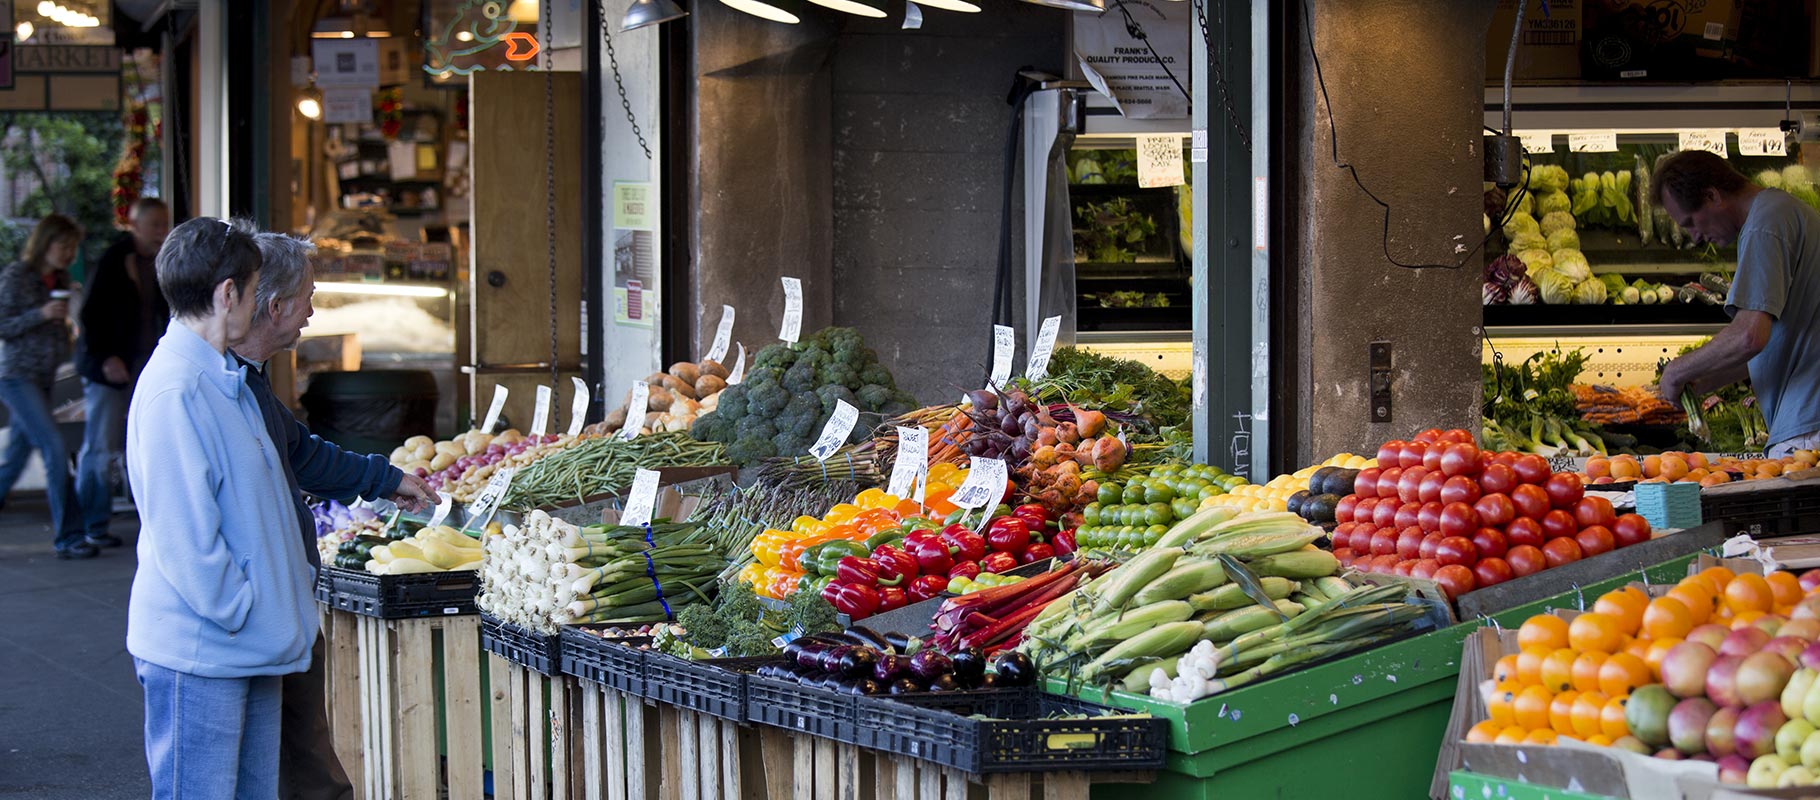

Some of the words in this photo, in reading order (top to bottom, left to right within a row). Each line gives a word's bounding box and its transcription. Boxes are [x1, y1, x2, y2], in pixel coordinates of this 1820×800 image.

[1113, 47, 1149, 55] FRANK'S
[1086, 55, 1120, 64] QUALITY
[1122, 55, 1161, 64] PRODUCE
[1162, 56, 1176, 64] CO.
[1547, 457, 1577, 467] RESH
